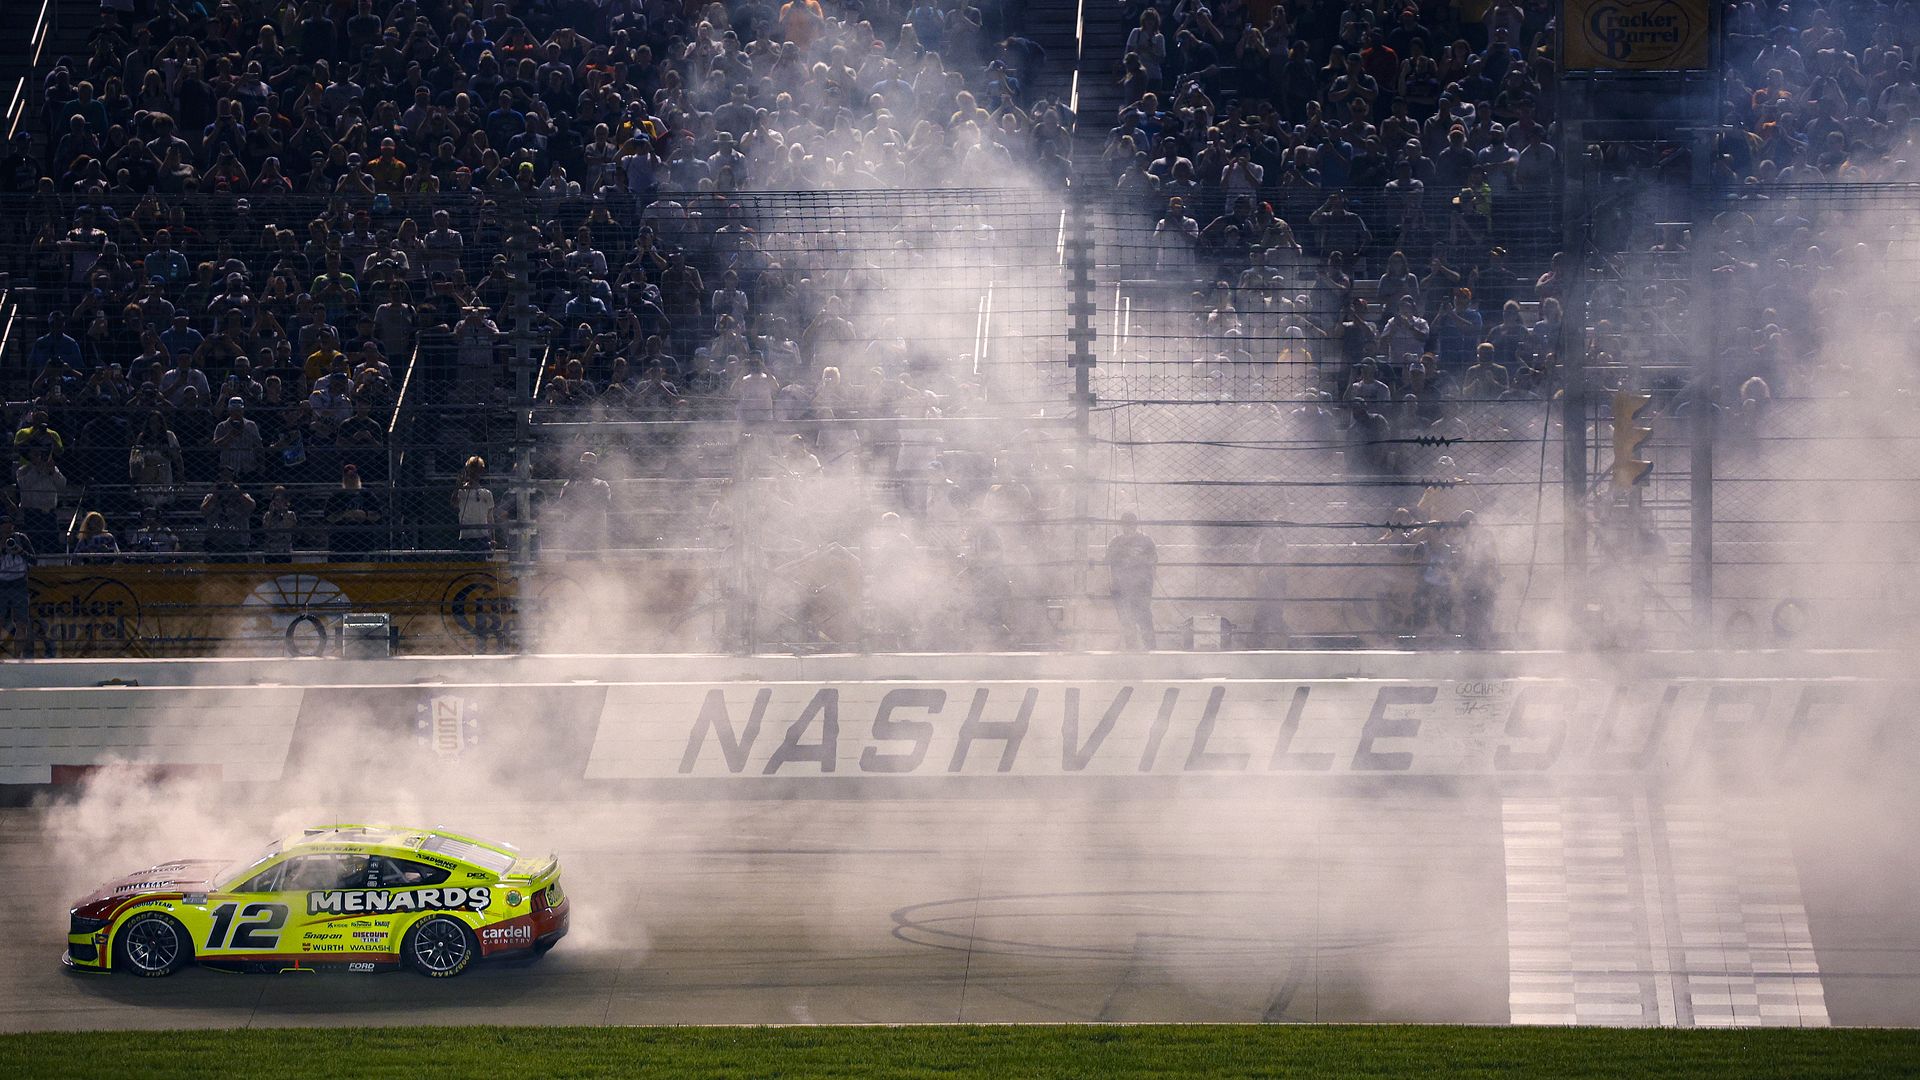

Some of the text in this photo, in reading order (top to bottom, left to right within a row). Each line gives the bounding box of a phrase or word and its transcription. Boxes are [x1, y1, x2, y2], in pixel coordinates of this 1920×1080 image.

[1591, 6, 1678, 41] Cracker
[1606, 28, 1679, 59] Barrel
[678, 686, 1438, 775] NASHVILLE
[307, 887, 491, 915] MENARDS
[203, 902, 289, 950] 12
[303, 932, 343, 940] Snap-on
[482, 926, 531, 939] cardell
[350, 944, 391, 952] WABASH
